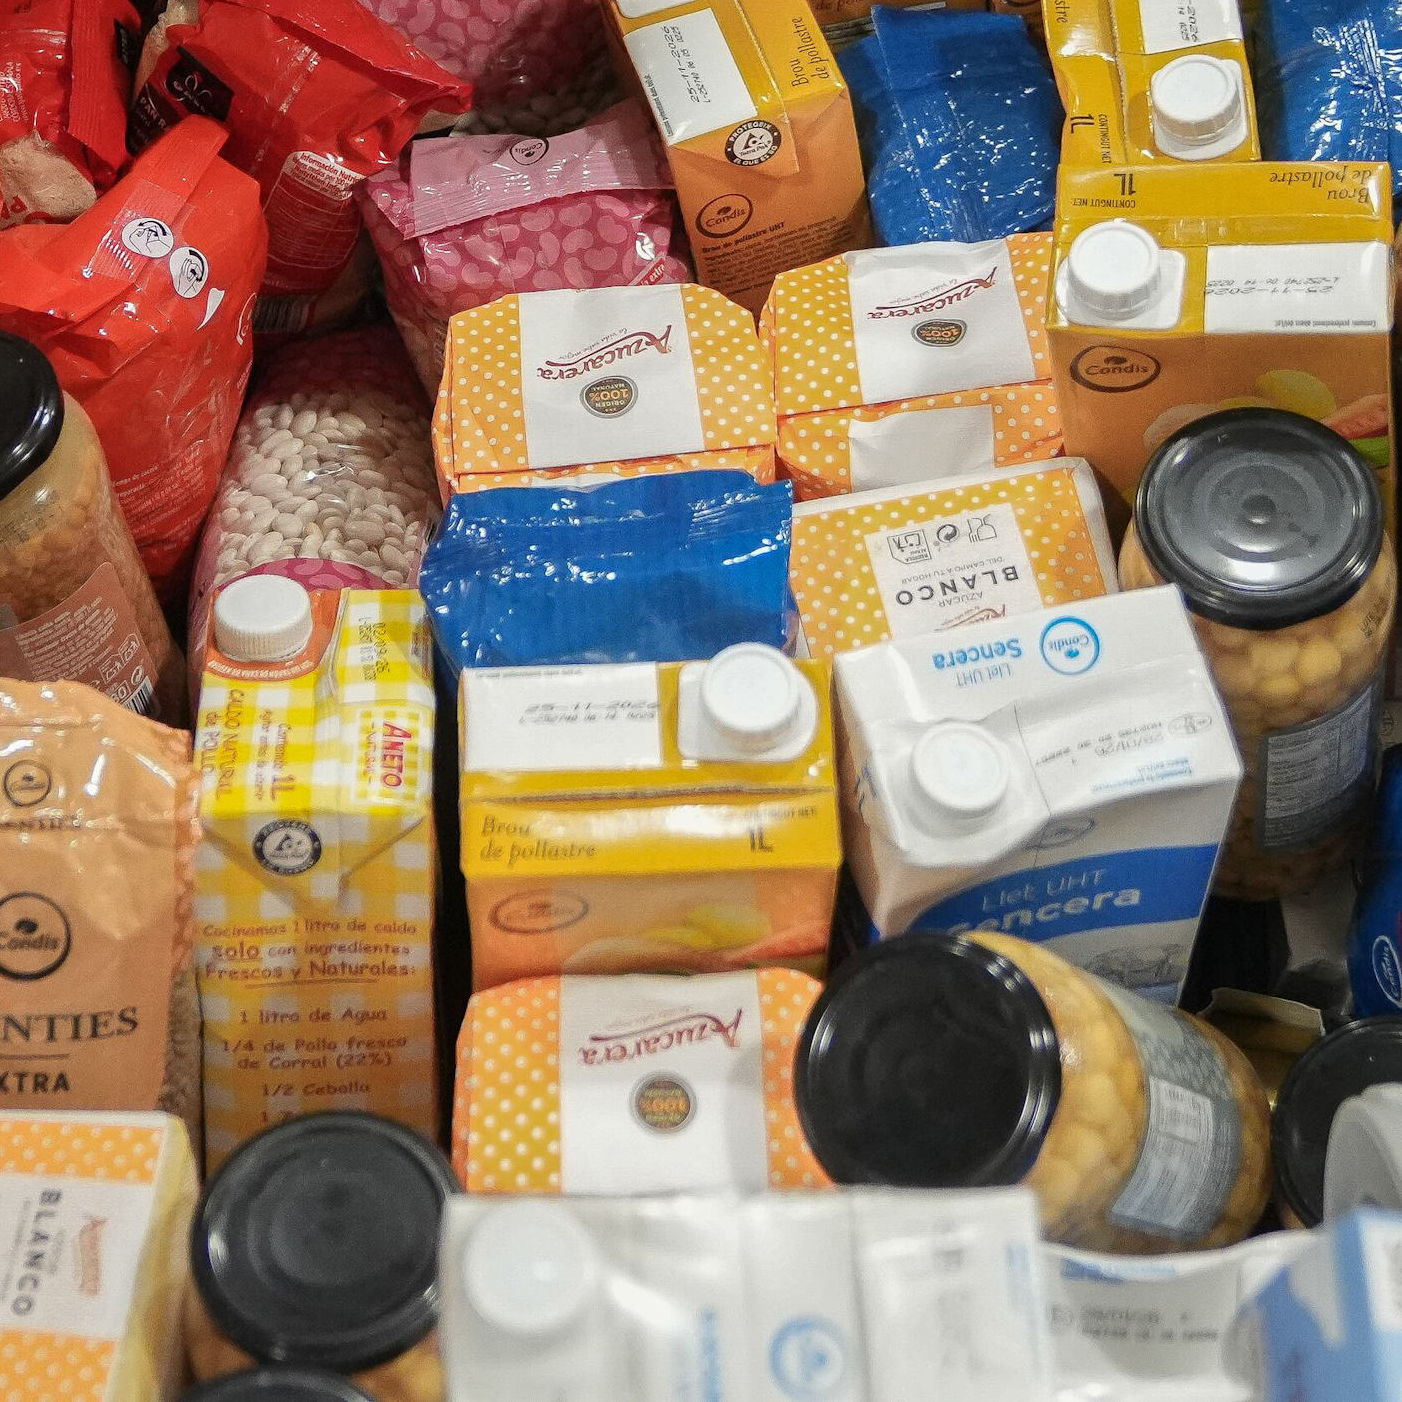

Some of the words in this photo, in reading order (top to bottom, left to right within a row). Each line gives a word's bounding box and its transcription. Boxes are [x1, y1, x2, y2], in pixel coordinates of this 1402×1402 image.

[791, 17, 829, 65] pollastre
[661, 25, 701, 104] 25-11-2026
[788, 58, 810, 88] Brou
[813, 66, 831, 80] de
[1070, 113, 1096, 135] 1L
[1097, 114, 1111, 151] CONTINGUT
[1114, 173, 1138, 197] 1L
[1269, 166, 1348, 188] pollastre
[1353, 169, 1372, 185] de
[1091, 198, 1137, 211] CONTINGUT
[1326, 187, 1371, 204] Brou
[705, 208, 747, 229] Condis
[769, 220, 785, 234] UHT
[650, 263, 665, 283] extra
[1284, 277, 1340, 287] L-252740
[868, 266, 998, 321] Azucarera
[1203, 285, 1335, 296] 25-11-2026
[920, 328, 959, 339] 100%
[536, 325, 674, 382] Azucarera
[1084, 362, 1150, 378] Condis
[589, 387, 630, 402] 100%
[592, 381, 626, 393] NATURAL
[594, 398, 626, 408] ORIGEN
[895, 565, 1019, 607] BLANCO
[938, 590, 984, 608] AZÚCAR
[931, 637, 1023, 672] Sencera
[1047, 634, 1090, 656] Condis
[955, 668, 983, 688] UHT
[224, 689, 245, 730] CALDO
[201, 726, 220, 769] POLLO
[381, 723, 412, 789] ANETO
[216, 733, 241, 800] NATURAL
[272, 774, 296, 800] 1L
[480, 814, 532, 838] Brou
[480, 839, 504, 861] de
[508, 837, 597, 865] pollastre
[202, 923, 287, 937] Cocinamos
[304, 917, 341, 932] litro
[346, 919, 367, 931] de
[373, 918, 418, 935] caldo
[211, 940, 260, 959] solo
[267, 946, 297, 957] con
[303, 941, 411, 958] ingredientes
[204, 957, 284, 980] Frescos
[258, 1008, 301, 1024] litro
[308, 1007, 333, 1024] de
[341, 1006, 388, 1026] Agua
[222, 1038, 255, 1053] 1/4
[262, 1037, 286, 1052] de
[293, 1037, 338, 1052] Pollo
[346, 1035, 408, 1051] fresco
[576, 1007, 744, 1066] Azucarera
[237, 1057, 260, 1070] de
[267, 1055, 328, 1070] Corral
[334, 1051, 393, 1069] (22%)
[262, 1082, 296, 1097] 1/2
[301, 1080, 372, 1097] Cebolla
[11, 1188, 65, 1318] BLANCO
